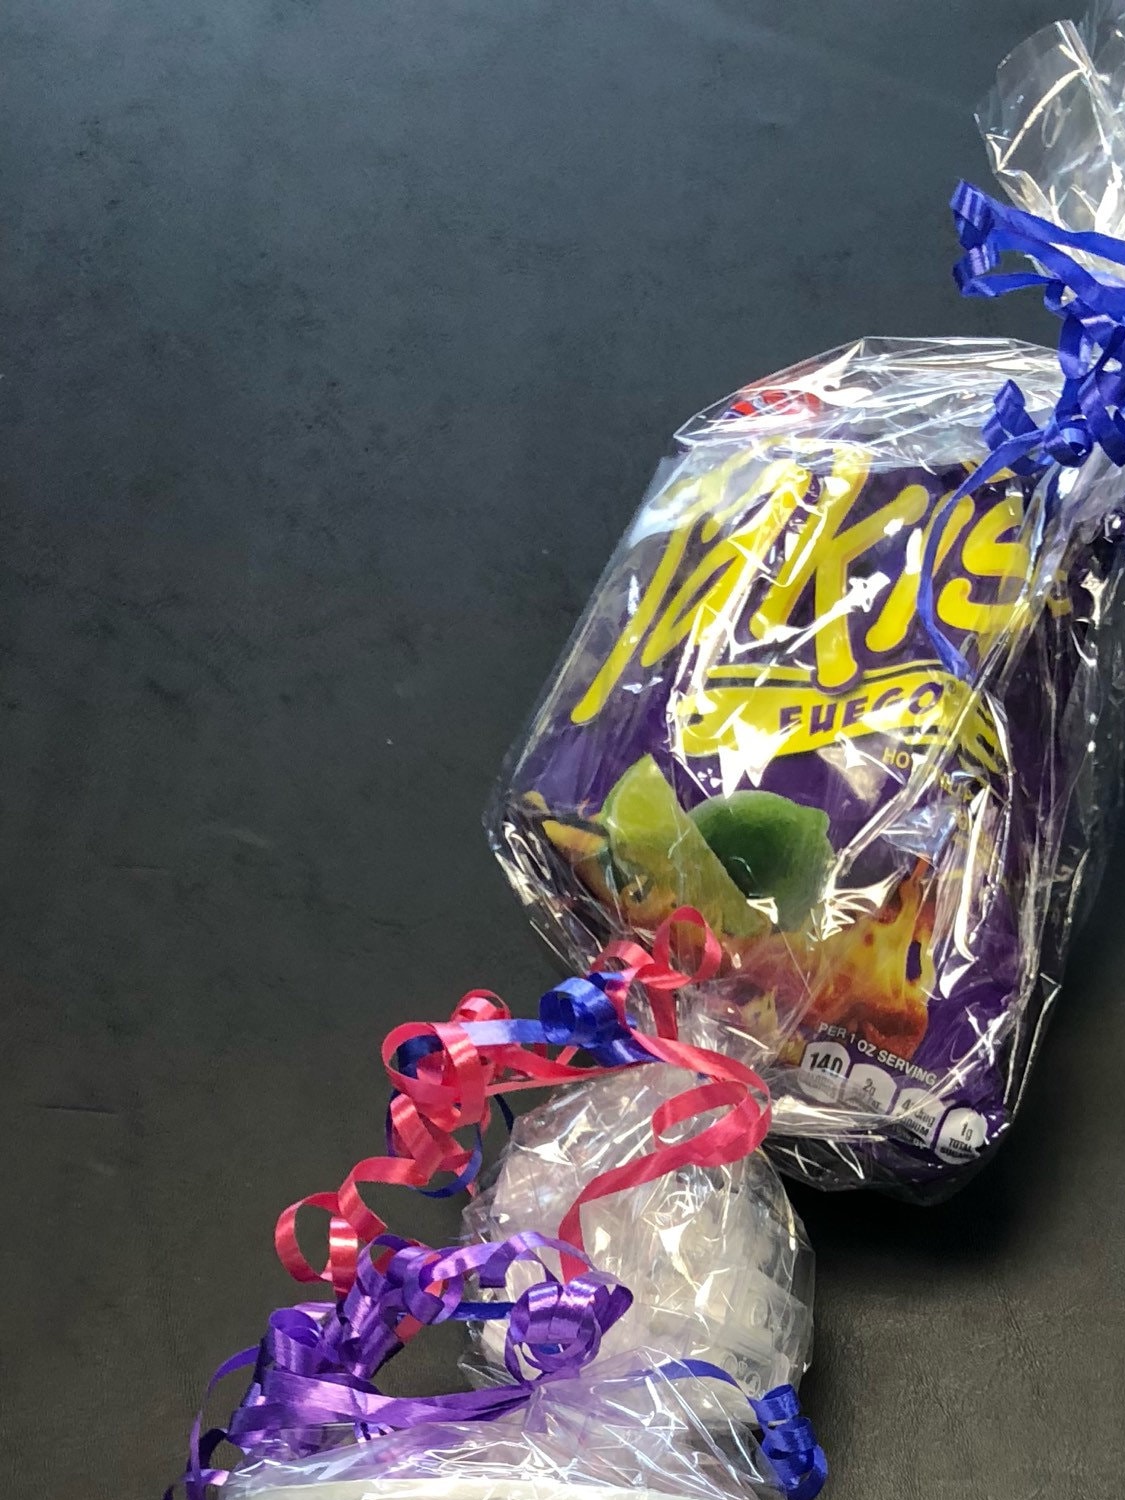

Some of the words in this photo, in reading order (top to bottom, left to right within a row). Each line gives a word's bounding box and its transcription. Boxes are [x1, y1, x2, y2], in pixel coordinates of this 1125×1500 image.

[779, 681, 944, 736] FUEGO
[810, 1051, 843, 1079] 140
[818, 1022, 847, 1039] PER
[857, 1039, 877, 1058] OZ
[877, 1049, 938, 1086] SERVING
